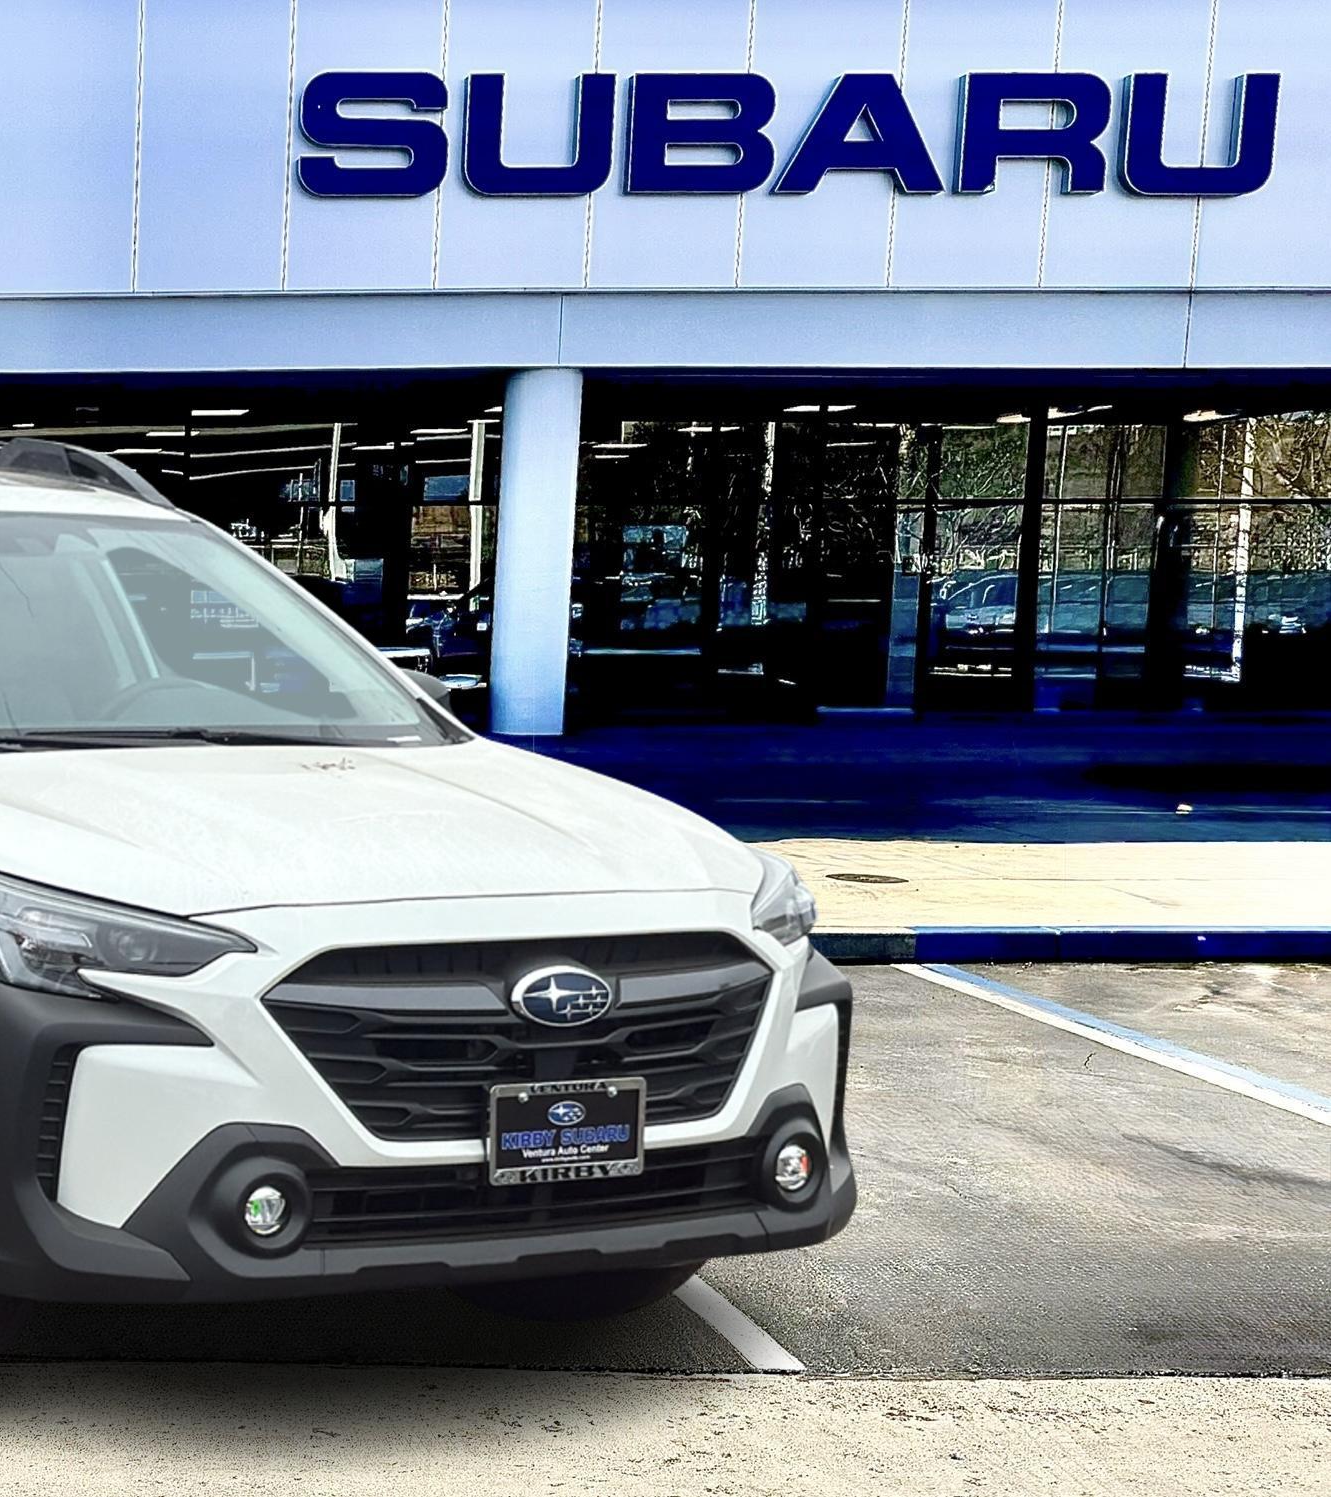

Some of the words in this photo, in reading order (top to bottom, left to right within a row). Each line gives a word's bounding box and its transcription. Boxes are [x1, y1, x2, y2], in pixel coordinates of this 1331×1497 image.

[297, 72, 1281, 198] SUBARU
[530, 1081, 609, 1094] VENTURA
[502, 1129, 556, 1150] KIRBY
[561, 1124, 630, 1145] SUBARU
[522, 1148, 555, 1158] Ventura
[558, 1146, 578, 1156] Auto
[580, 1144, 609, 1154] Center
[520, 1163, 615, 1182] KIRBY
